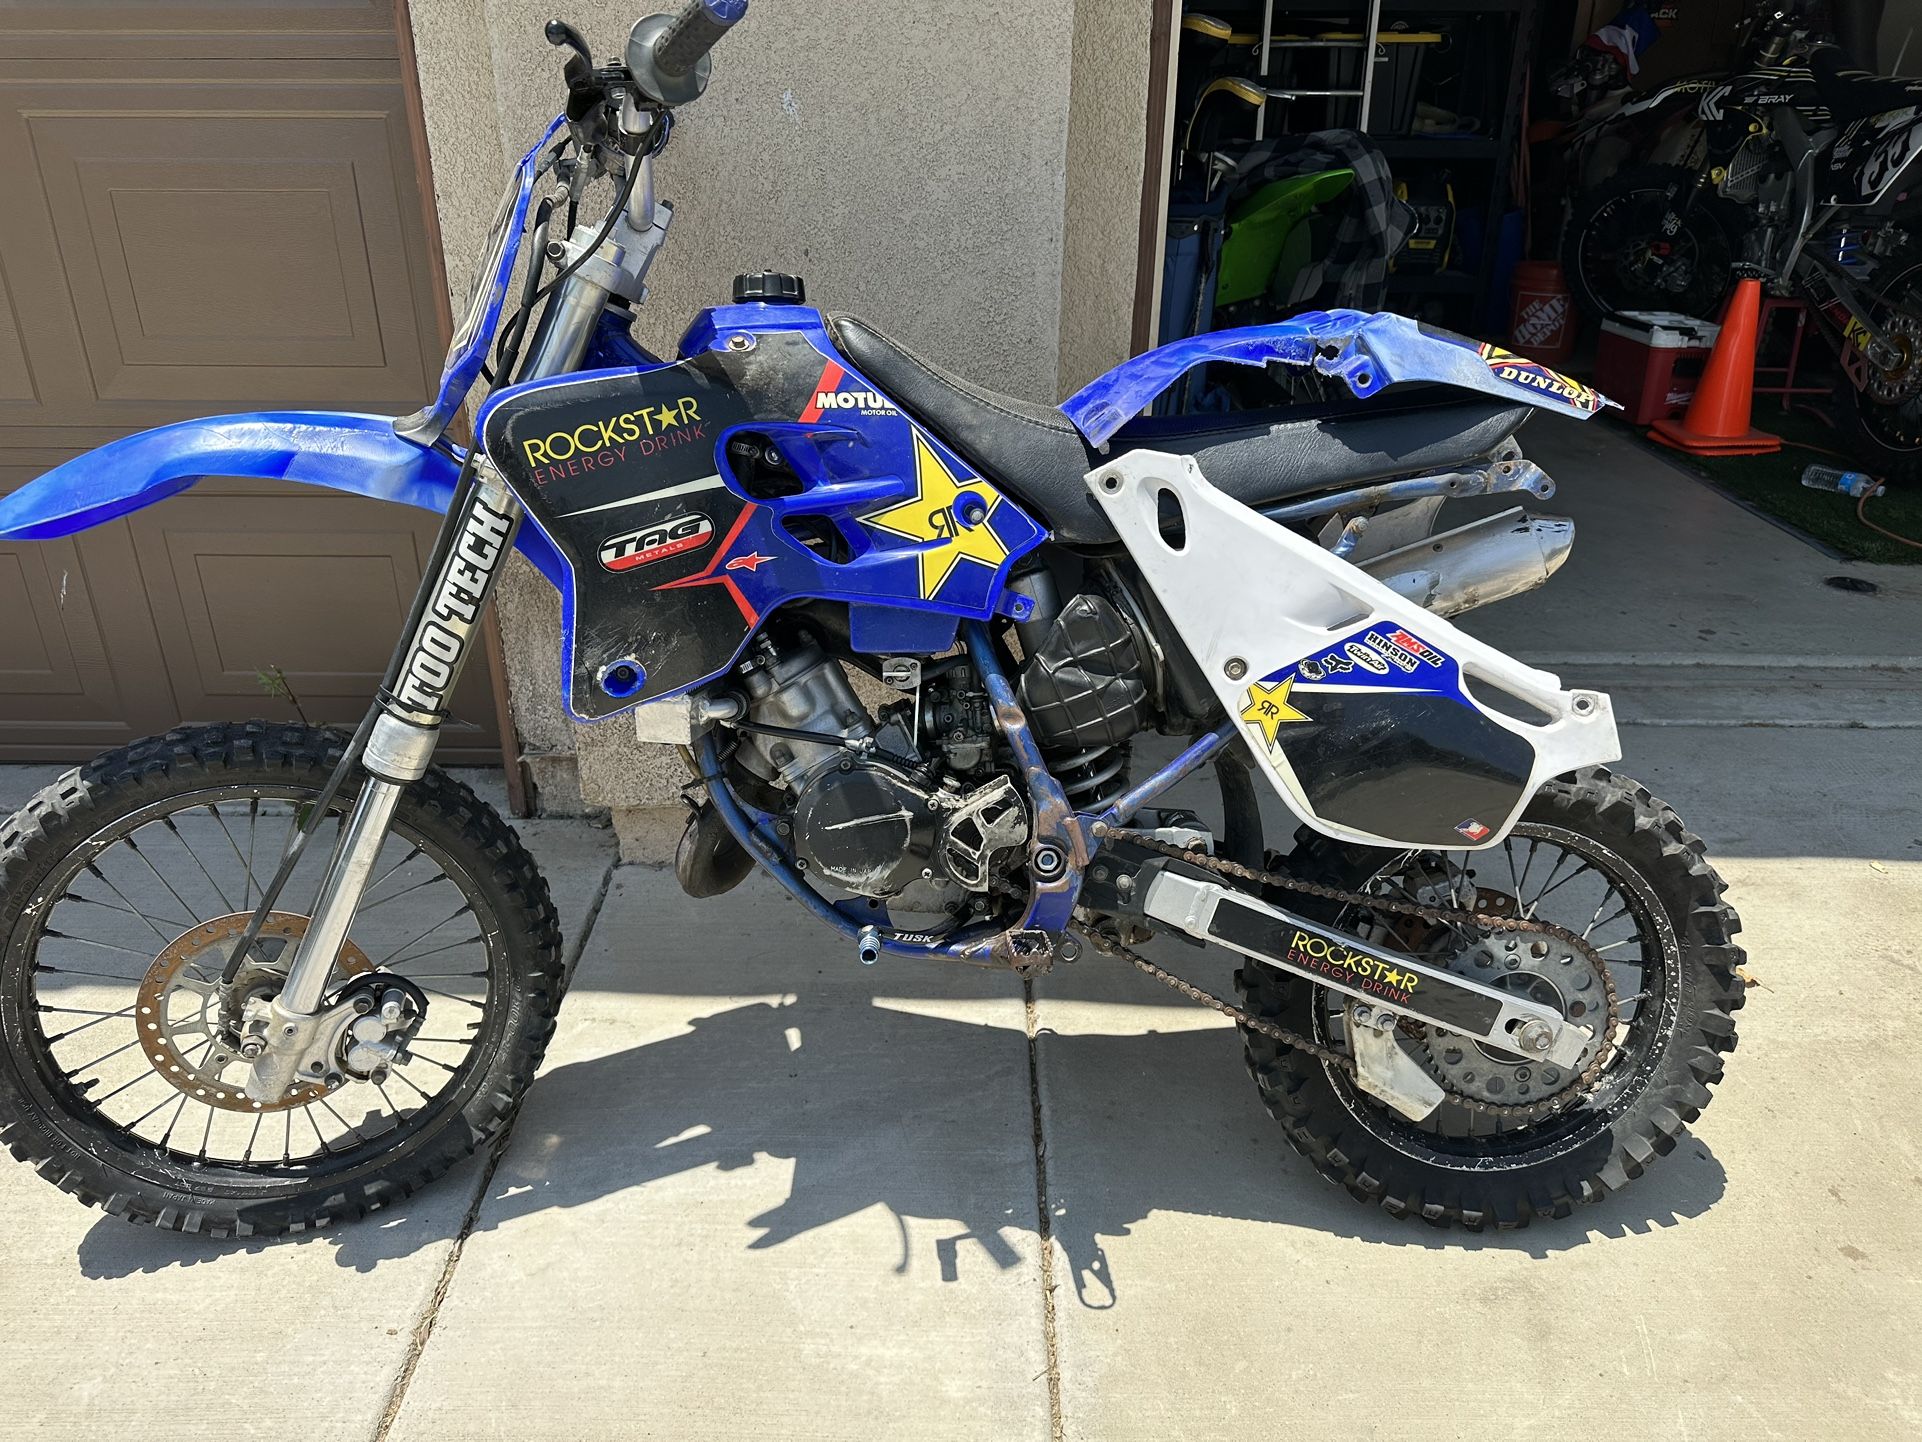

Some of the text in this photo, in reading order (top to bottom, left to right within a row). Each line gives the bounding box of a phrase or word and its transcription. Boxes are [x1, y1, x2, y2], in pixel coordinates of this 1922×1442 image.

[1514, 295, 1566, 345] HOME
[1500, 366, 1593, 402] DUNLOP
[535, 424, 706, 485] ENERGY DRINK
[602, 517, 708, 559] TAG
[635, 543, 684, 561] METALS
[399, 497, 513, 712] TOO TECH
[1368, 633, 1417, 666] HINSON
[1390, 630, 1443, 666] AMSOIL
[894, 932, 934, 943] TUSK
[1287, 949, 1411, 1004] ENERGY DRINK
